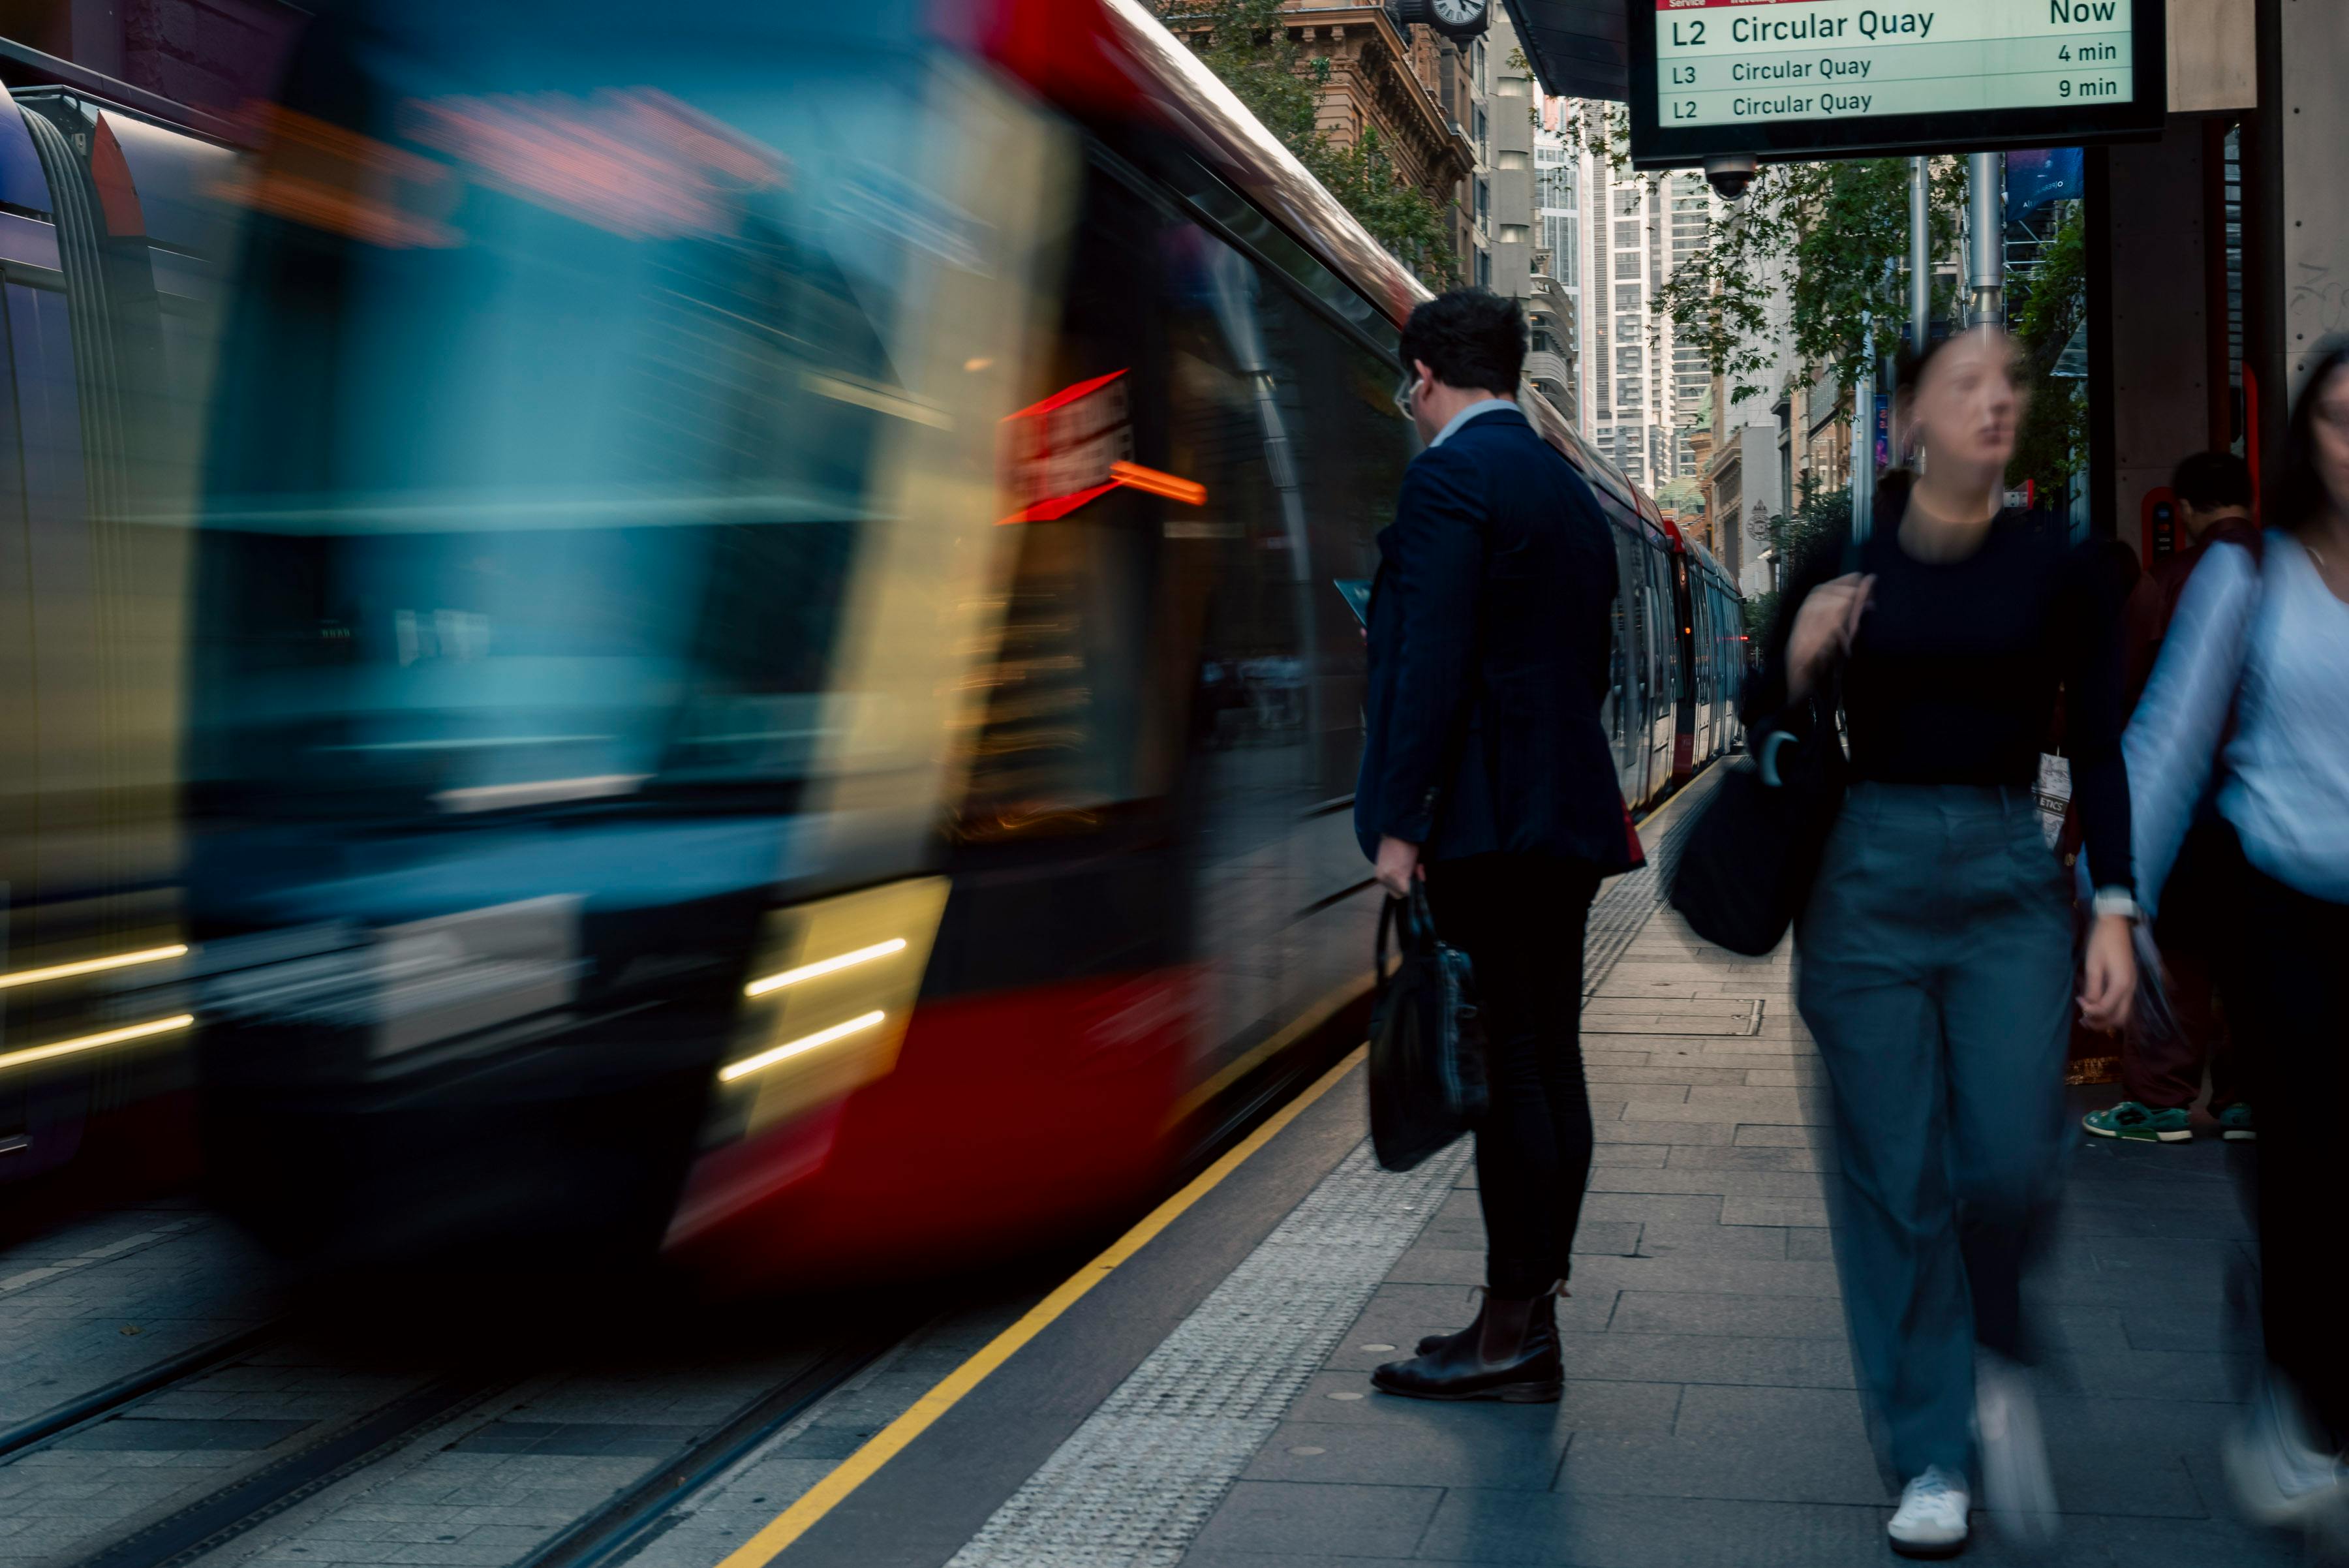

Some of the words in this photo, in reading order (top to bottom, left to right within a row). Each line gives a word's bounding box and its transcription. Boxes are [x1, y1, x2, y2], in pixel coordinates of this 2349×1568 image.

[1673, 20, 1706, 46] L2
[1732, 12, 1848, 42] Circular
[1859, 10, 1934, 40] Quay
[2051, 0, 2116, 24] Now
[1673, 66, 1696, 84] L3
[1732, 60, 1813, 81] Circular
[1820, 58, 1871, 80] Quay
[2058, 44, 2072, 62] 4
[2079, 42, 2116, 61] min
[1674, 100, 1697, 119] L2
[1733, 95, 1813, 116] Circular
[1820, 93, 1872, 114] Quay
[2059, 80, 2071, 98] 9
[2079, 77, 2117, 97] min
